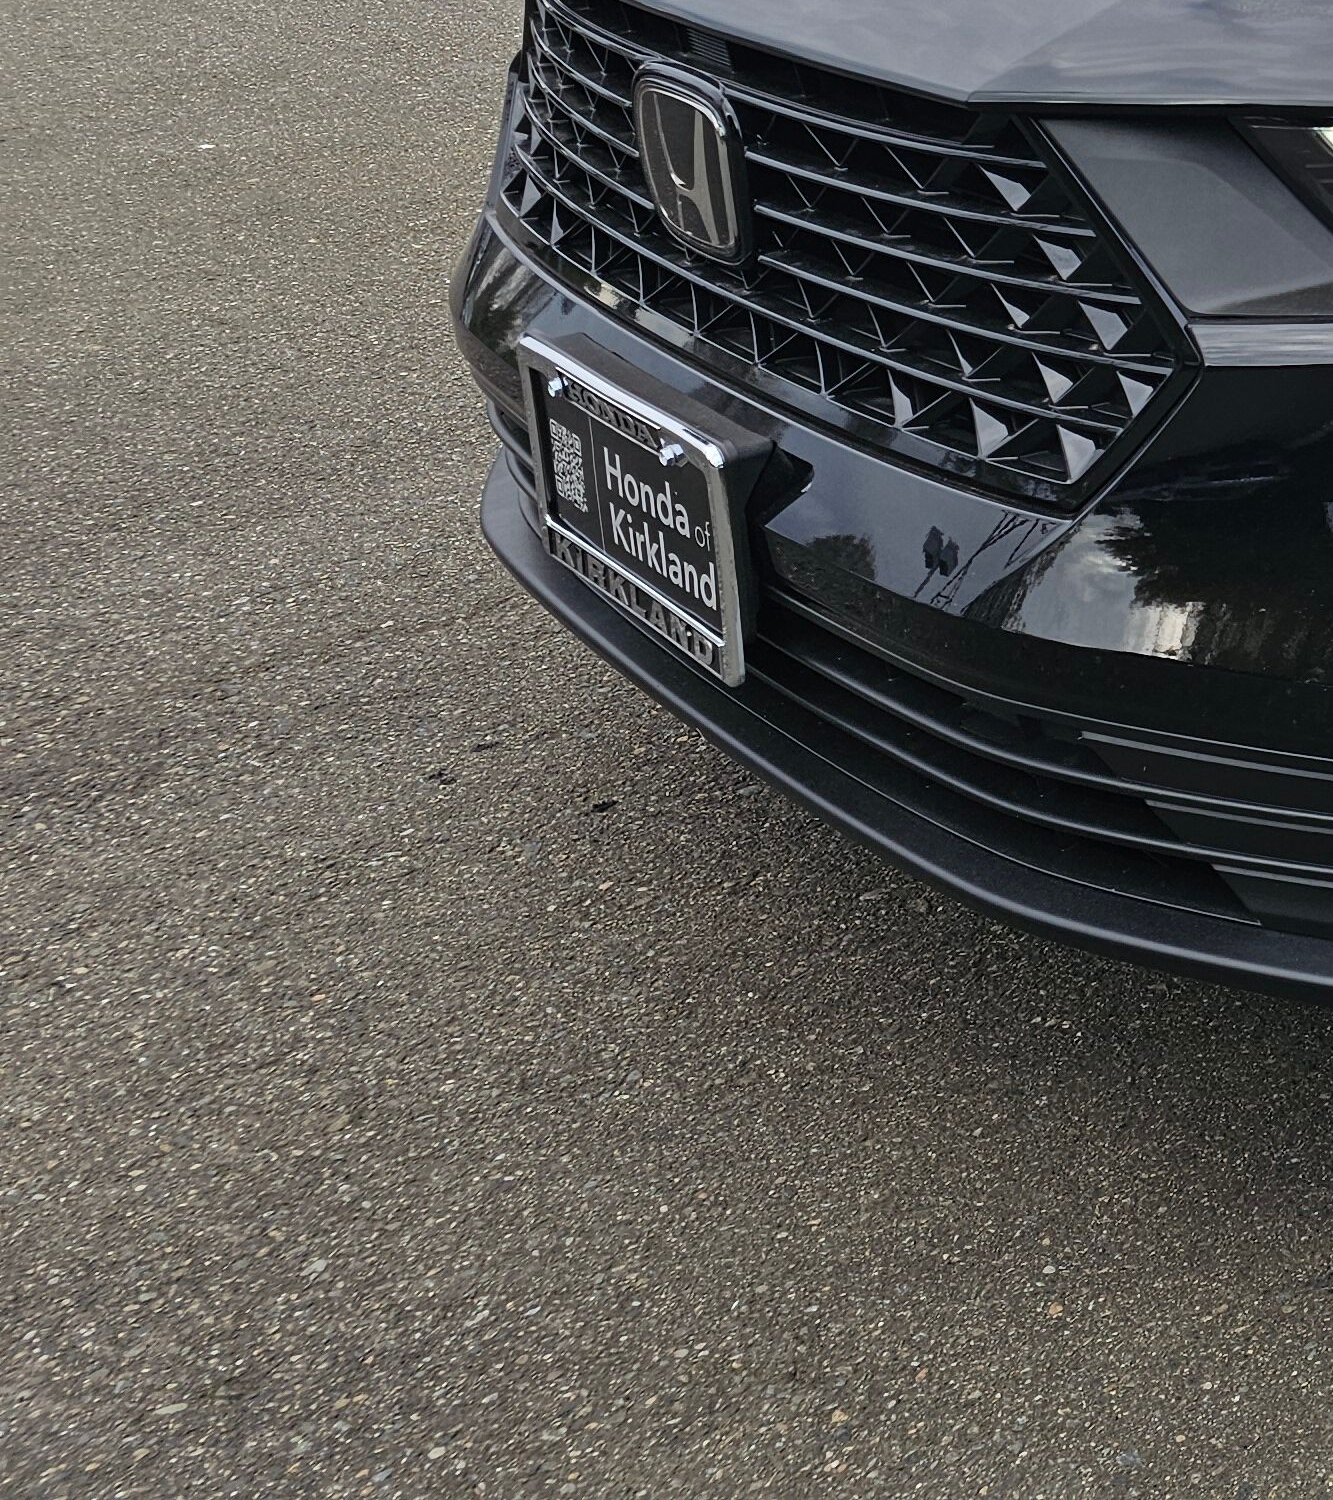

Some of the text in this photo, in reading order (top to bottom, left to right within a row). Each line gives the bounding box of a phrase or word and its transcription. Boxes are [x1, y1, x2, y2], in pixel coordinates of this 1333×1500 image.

[564, 380, 660, 449] HONDA
[603, 446, 711, 553] Honda of
[554, 532, 714, 667] KIRKLAND
[608, 501, 717, 611] Kirkland
